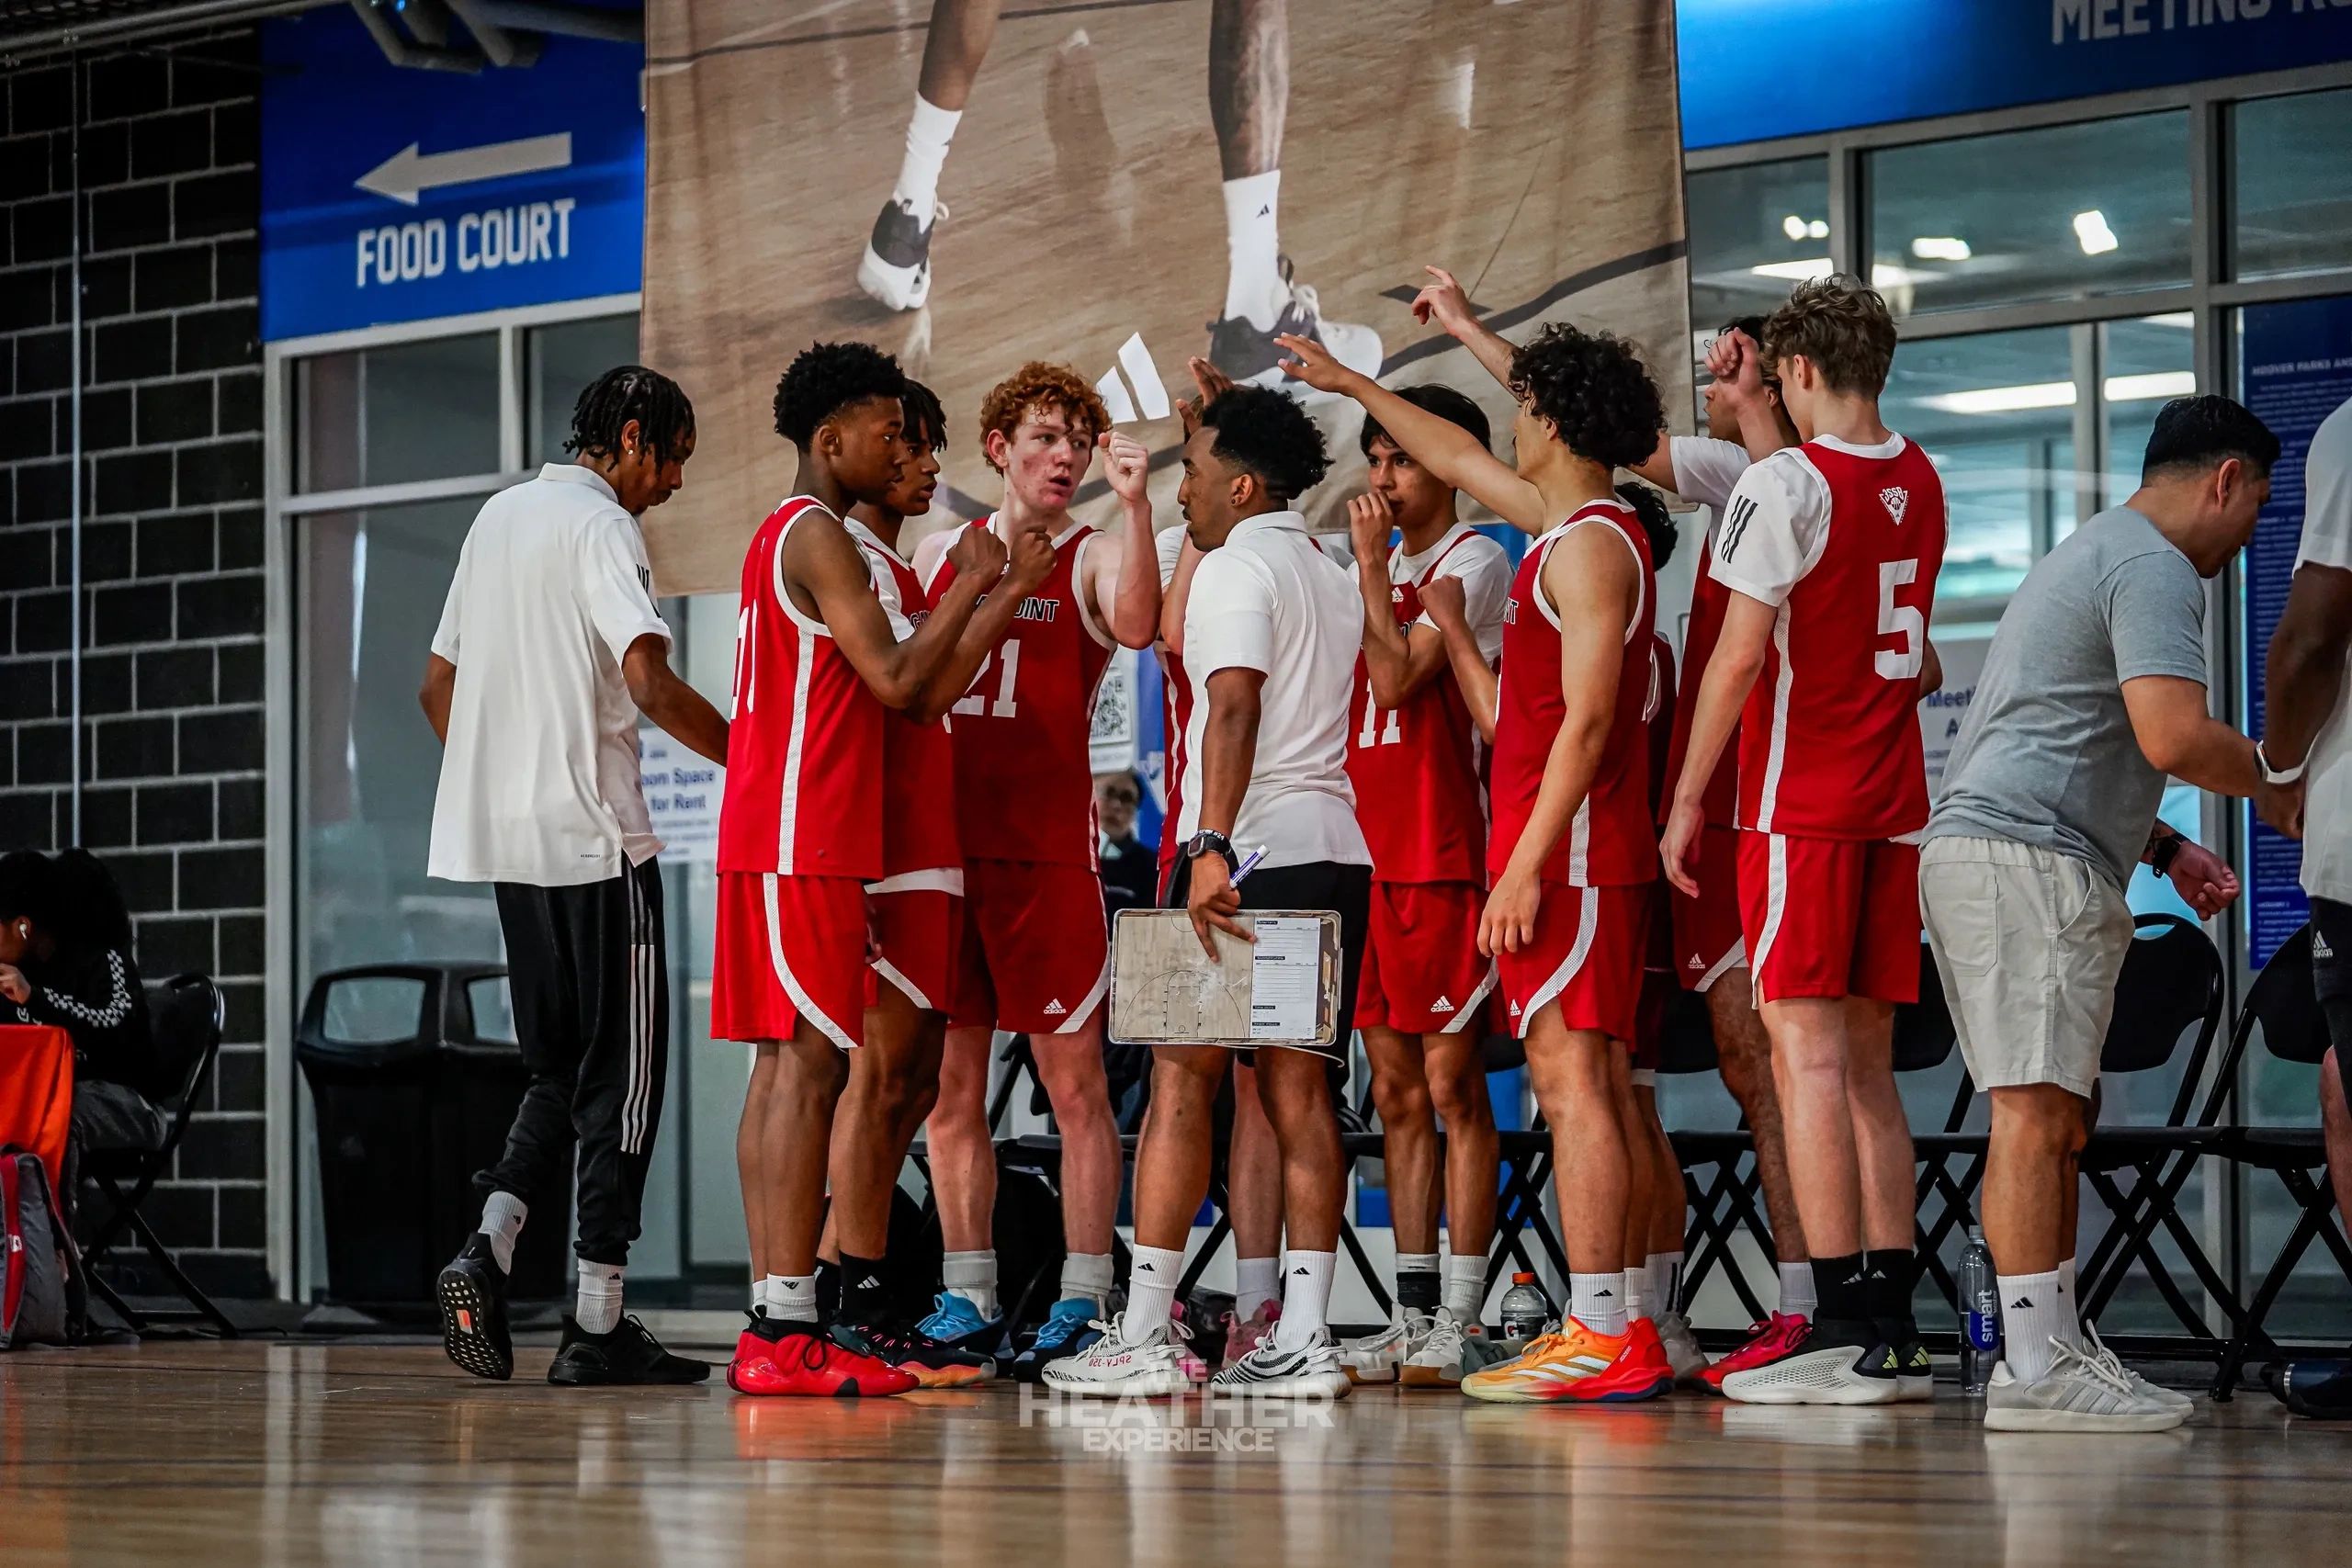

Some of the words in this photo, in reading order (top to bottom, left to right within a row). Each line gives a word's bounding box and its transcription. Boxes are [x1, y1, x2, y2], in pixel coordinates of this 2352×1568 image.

[356, 219, 447, 288] FOOD
[458, 197, 576, 271] COURT
[1874, 558, 1924, 680] 5
[1926, 685, 1977, 708] Meet
[641, 773, 670, 787] oom
[673, 767, 716, 788] Space
[650, 795, 669, 812] for
[673, 793, 707, 810] Rent
[1977, 1289, 1994, 1343] smart
